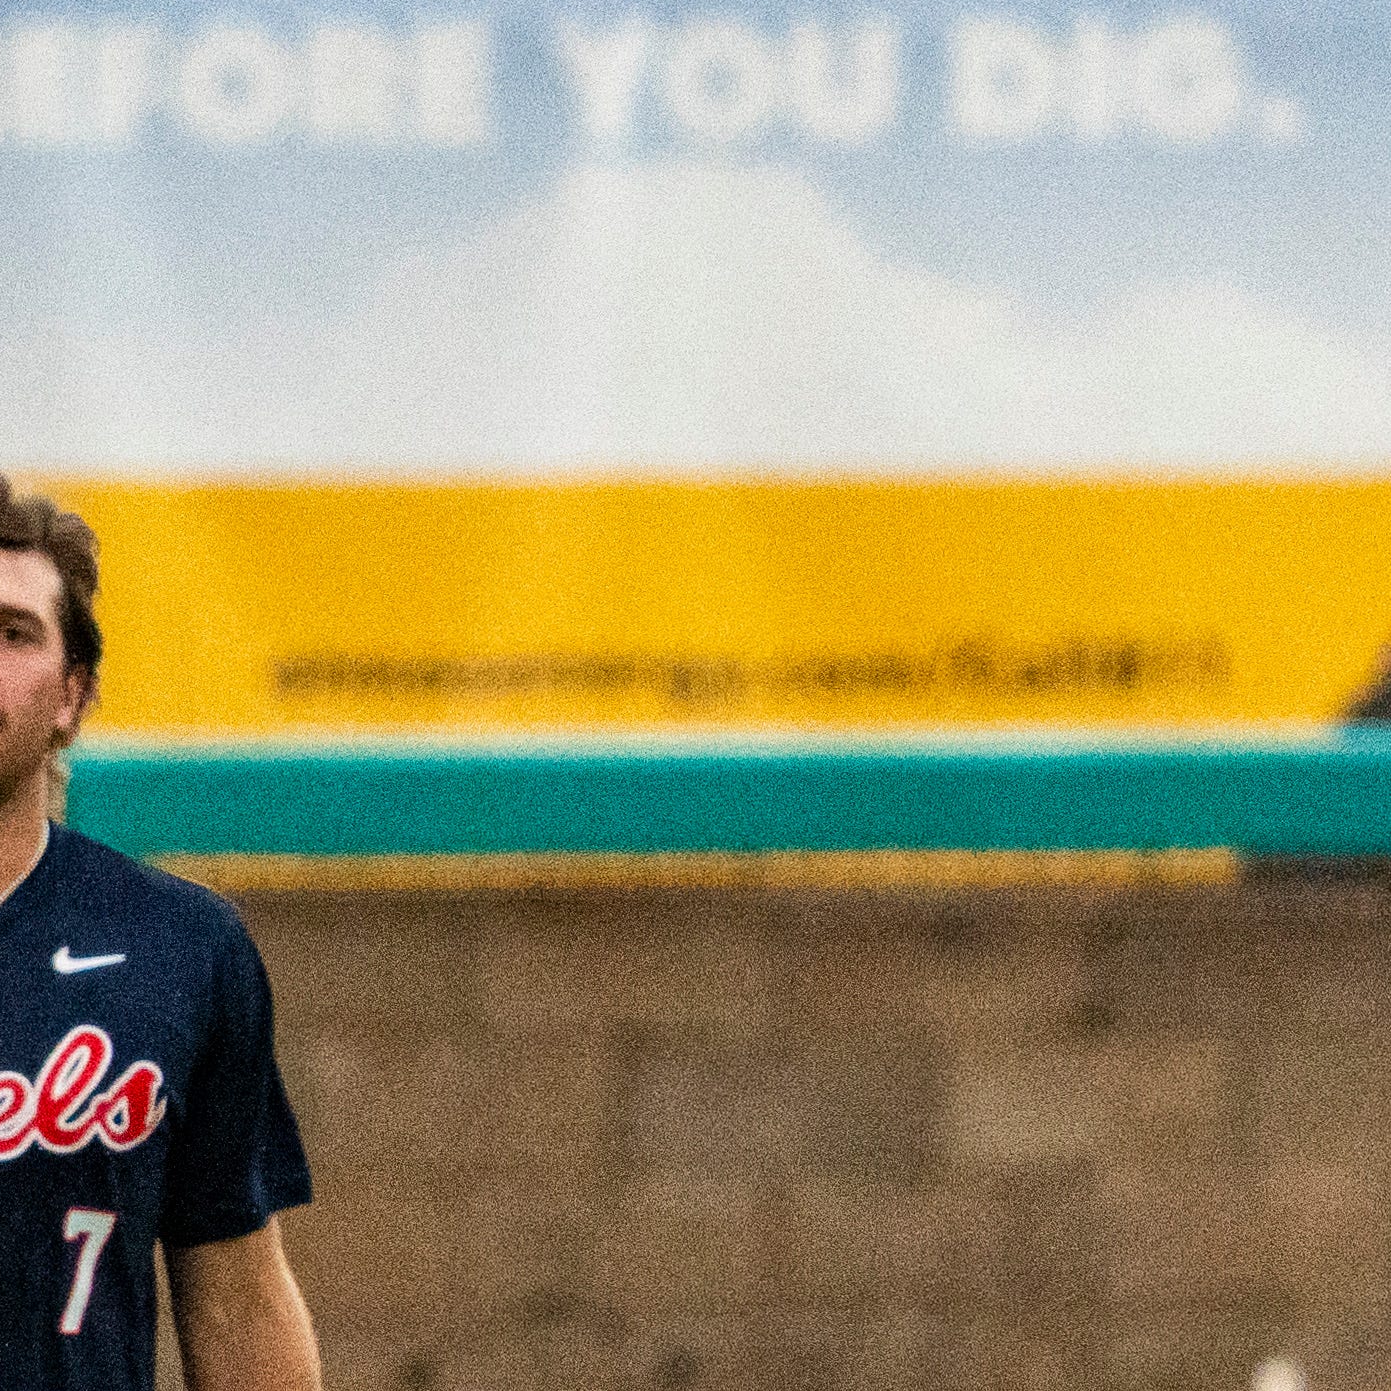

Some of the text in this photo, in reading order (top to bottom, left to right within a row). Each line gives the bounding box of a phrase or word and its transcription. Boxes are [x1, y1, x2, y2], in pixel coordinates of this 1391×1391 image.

[556, 16, 905, 146] YOU
[950, 16, 1306, 144] DIG.
[58, 1208, 117, 1335] 7
